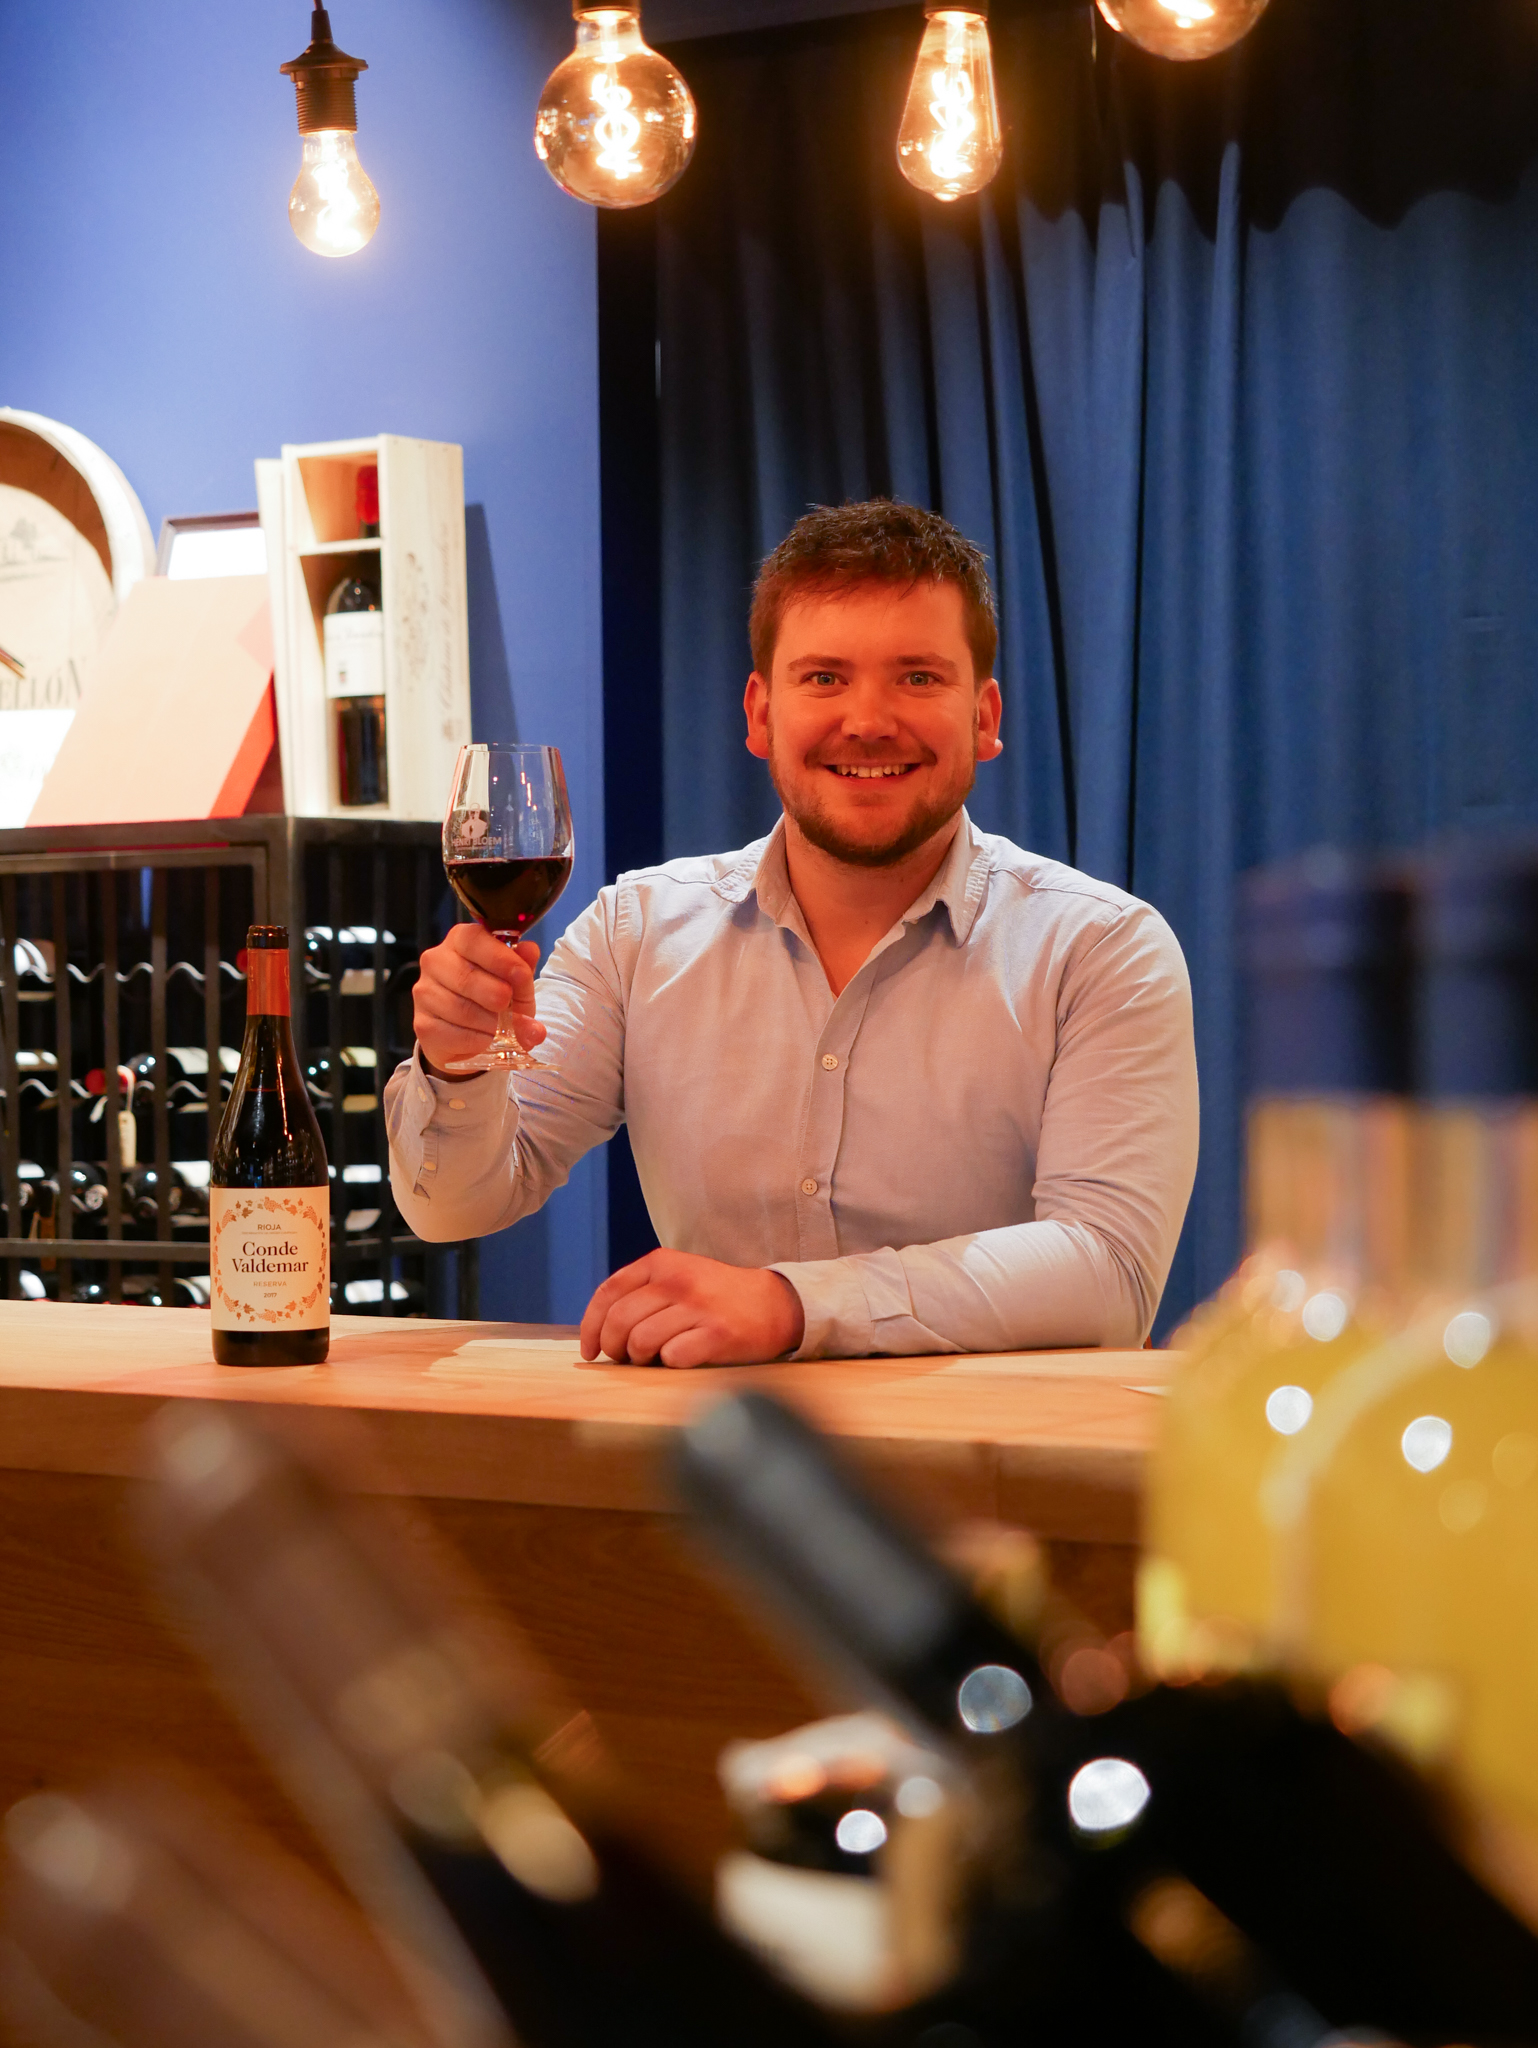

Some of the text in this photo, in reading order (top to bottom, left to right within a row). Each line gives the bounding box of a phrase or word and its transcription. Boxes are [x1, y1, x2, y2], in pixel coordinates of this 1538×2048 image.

[472, 836, 502, 845] BLOEM
[242, 1241, 298, 1257] Conde
[231, 1258, 309, 1273] Valdemar
